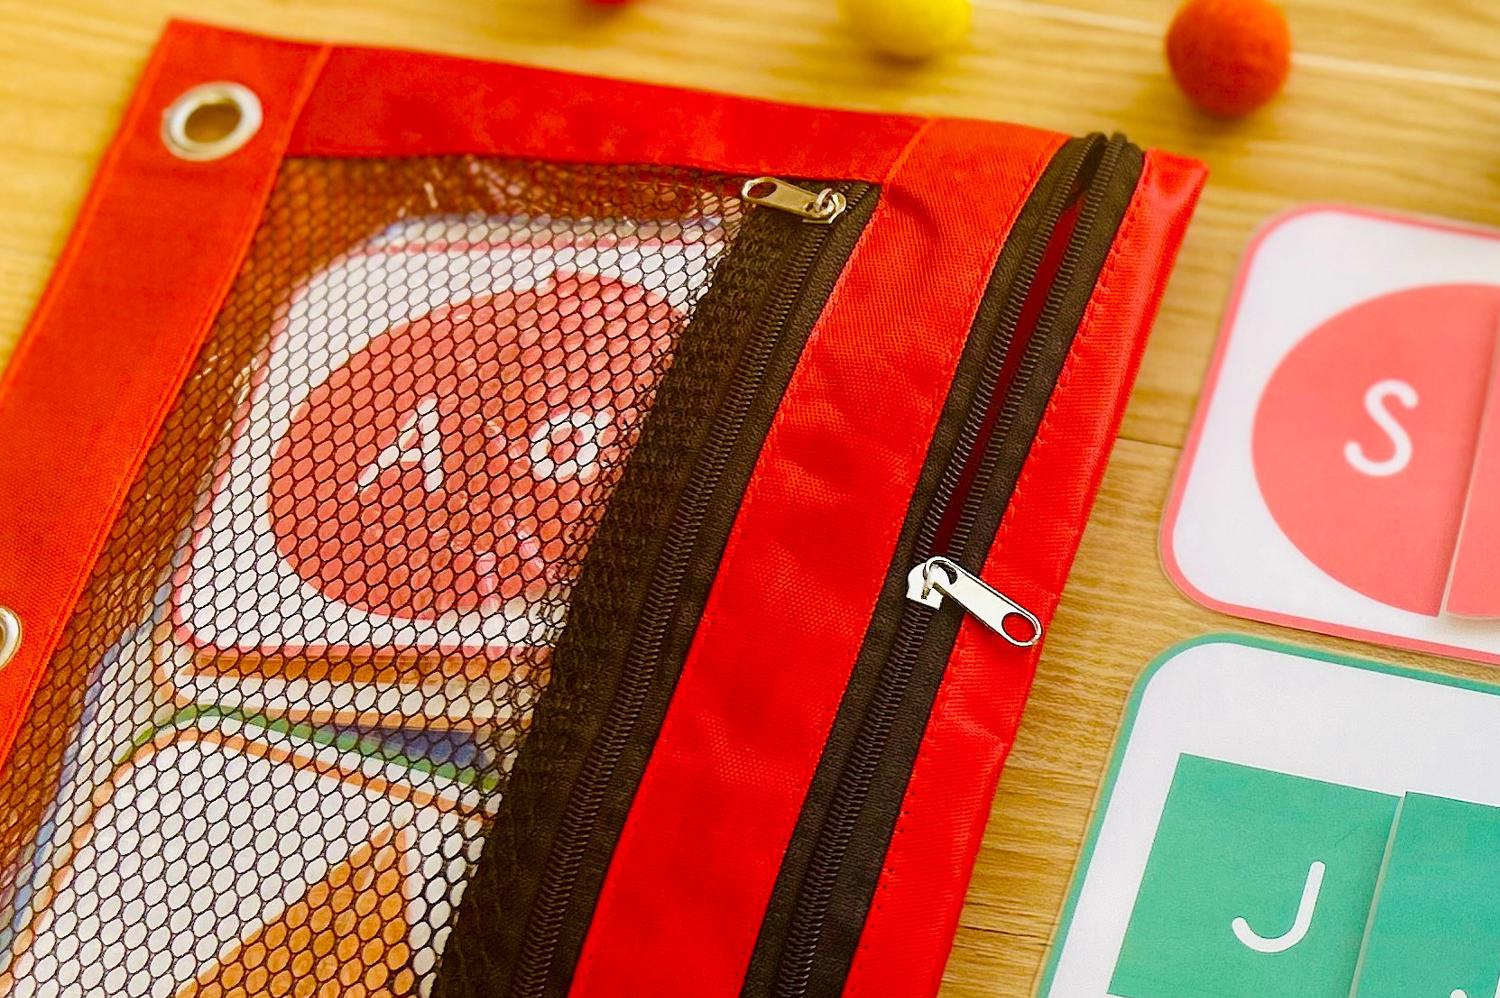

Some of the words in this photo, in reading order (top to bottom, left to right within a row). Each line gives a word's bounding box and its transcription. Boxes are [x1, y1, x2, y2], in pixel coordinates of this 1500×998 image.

[353, 396, 441, 492] A
[1343, 379, 1419, 477] S
[1231, 861, 1326, 953] J
